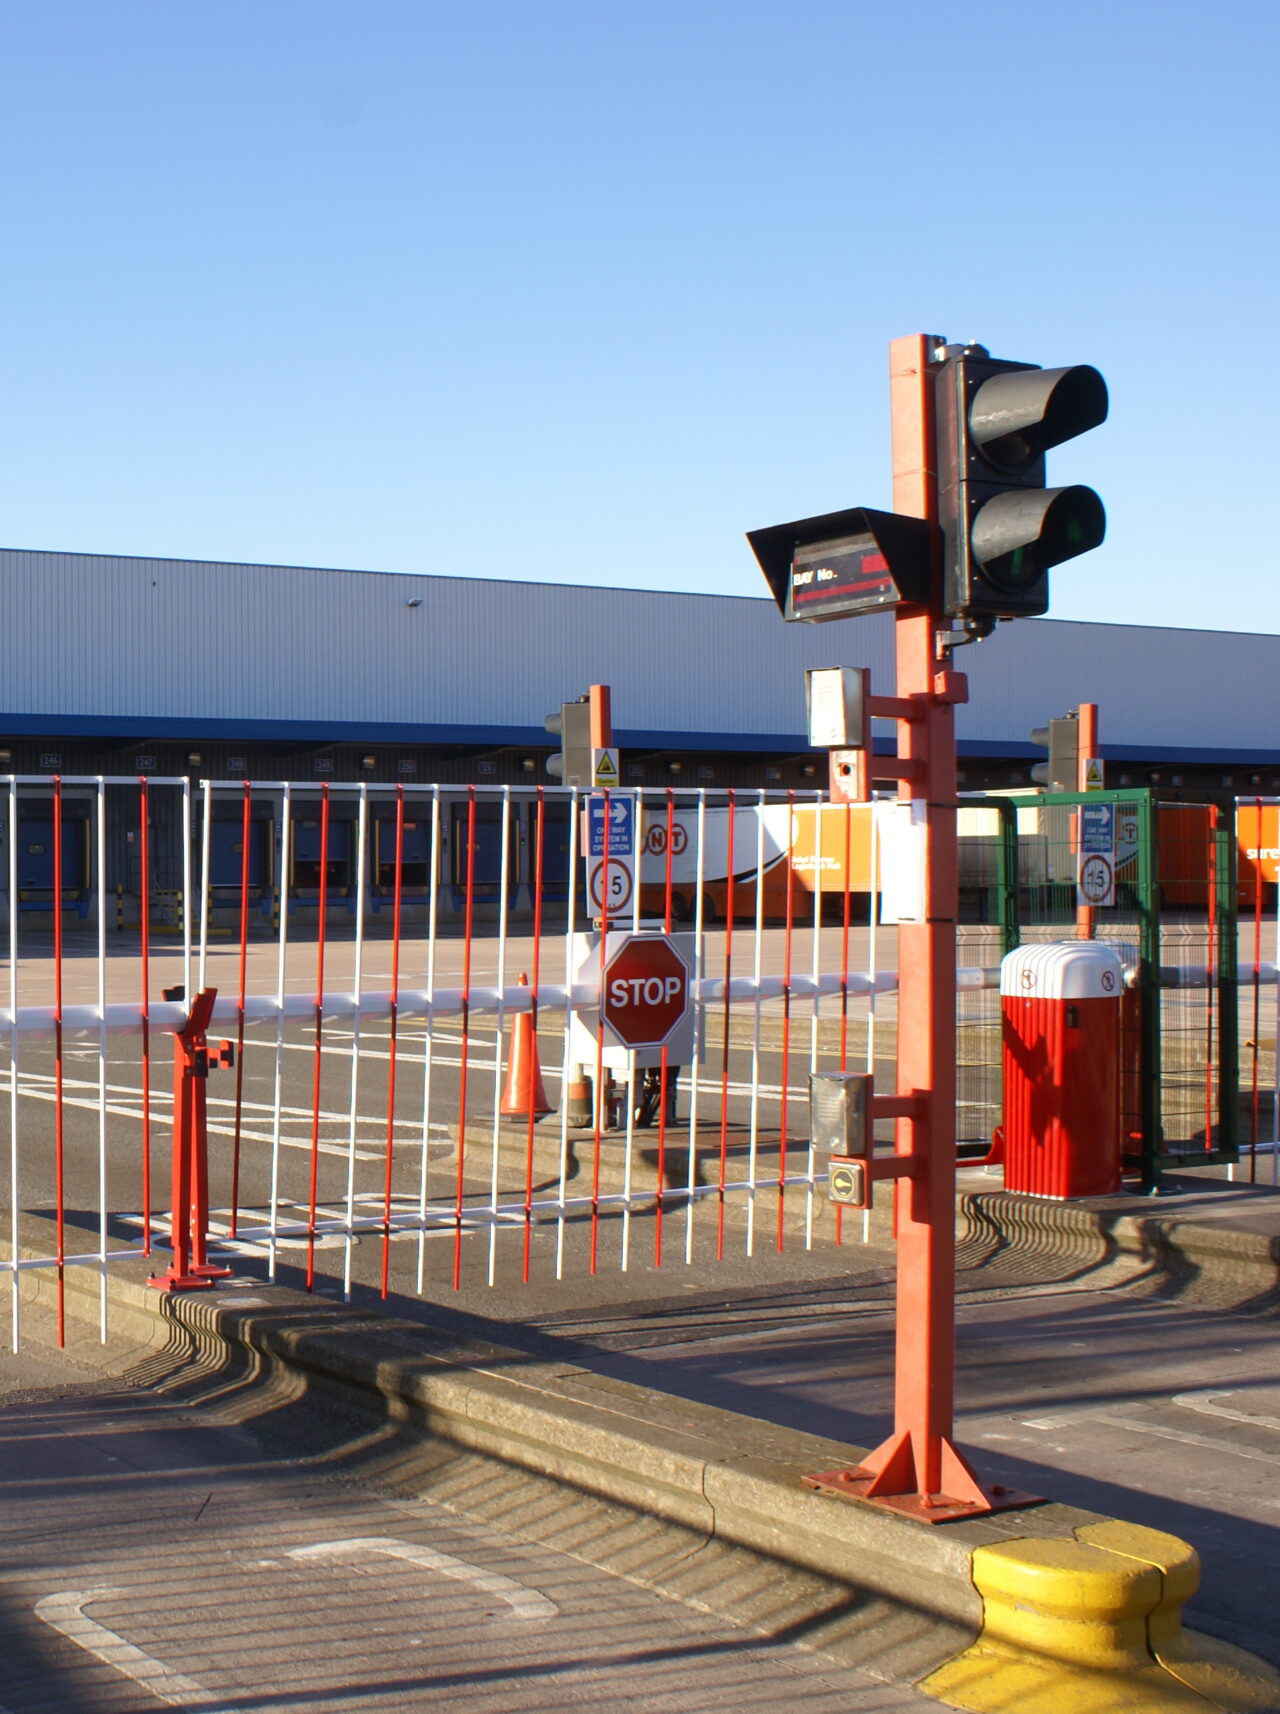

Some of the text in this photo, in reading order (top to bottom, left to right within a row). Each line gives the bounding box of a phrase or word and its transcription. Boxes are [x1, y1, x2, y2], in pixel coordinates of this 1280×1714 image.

[793, 571, 814, 586] BAY
[139, 757, 154, 767] 247
[1087, 871, 1104, 887] 15
[610, 977, 681, 1008] STOP
